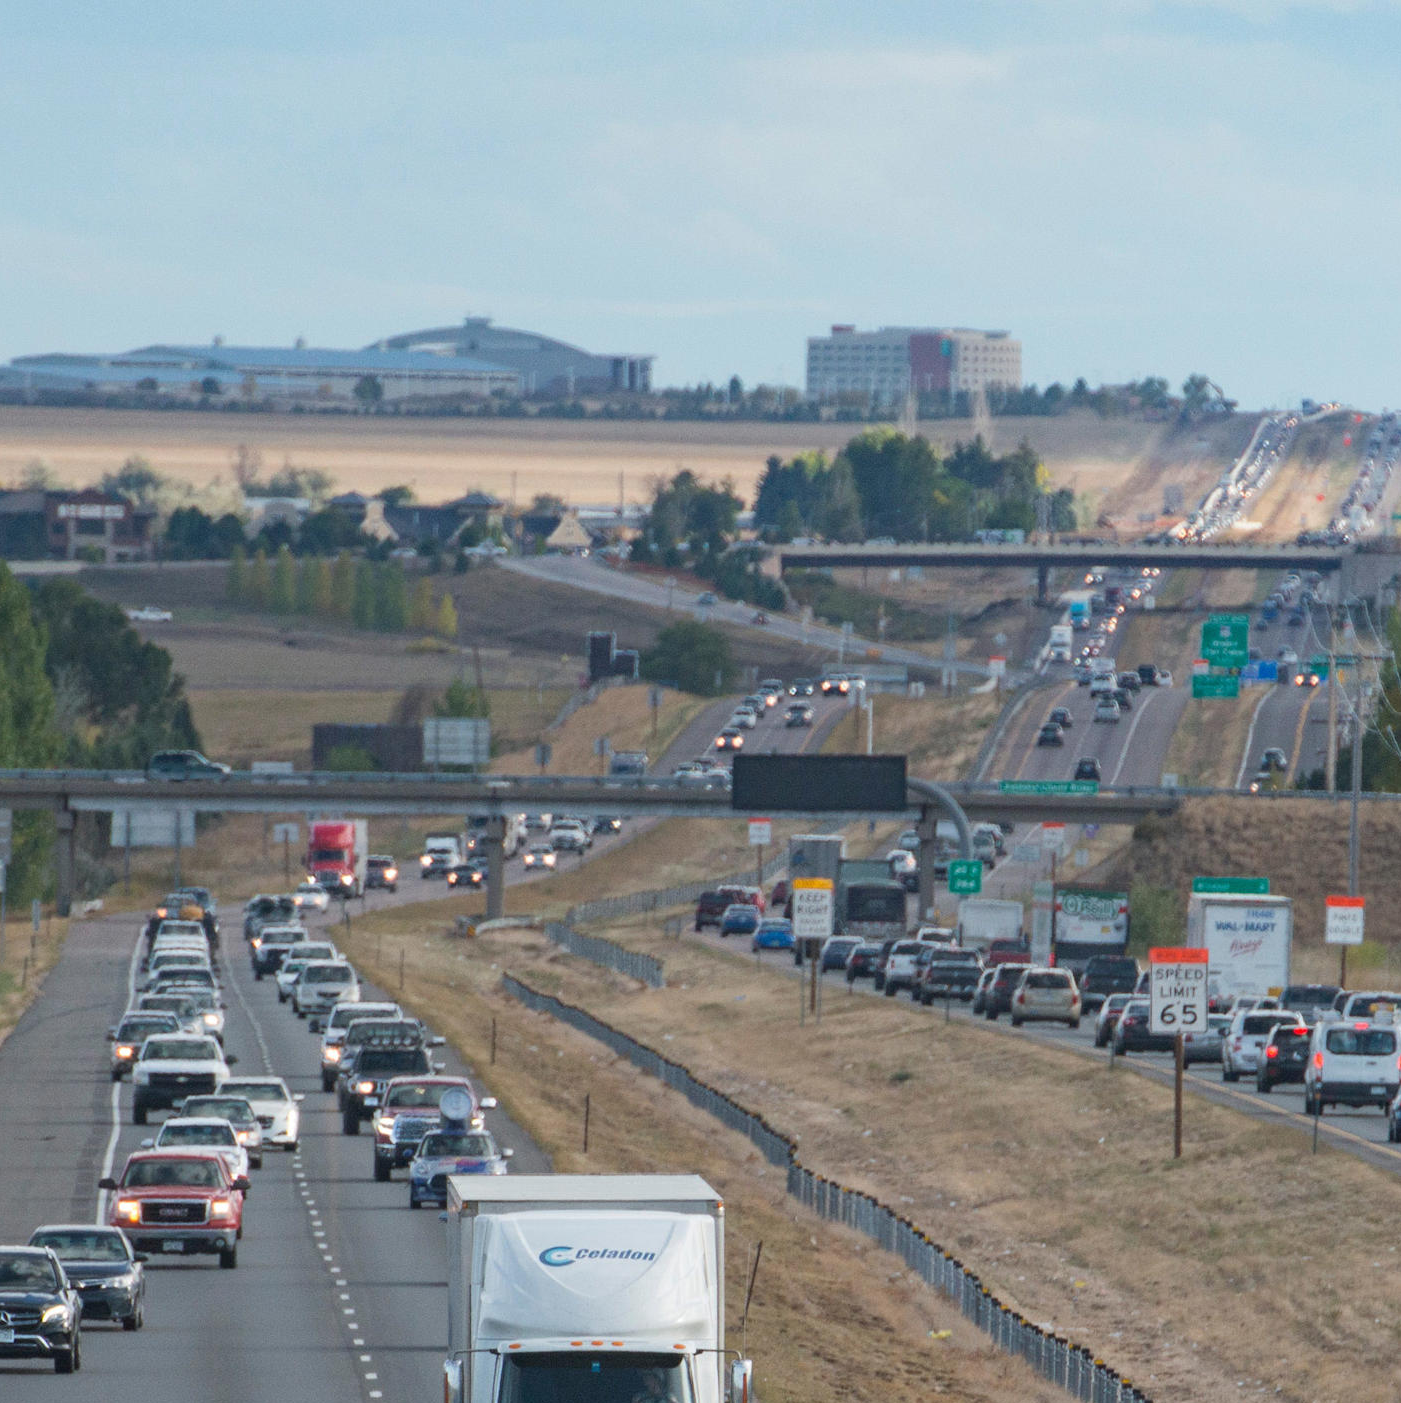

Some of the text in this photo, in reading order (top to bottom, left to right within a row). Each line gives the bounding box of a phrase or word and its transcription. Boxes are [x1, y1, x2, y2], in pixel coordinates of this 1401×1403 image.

[1156, 968, 1203, 980] SPEED
[1160, 986, 1197, 998] LIMIT
[1160, 1004, 1197, 1025] 65
[574, 1248, 656, 1261] Celadon
